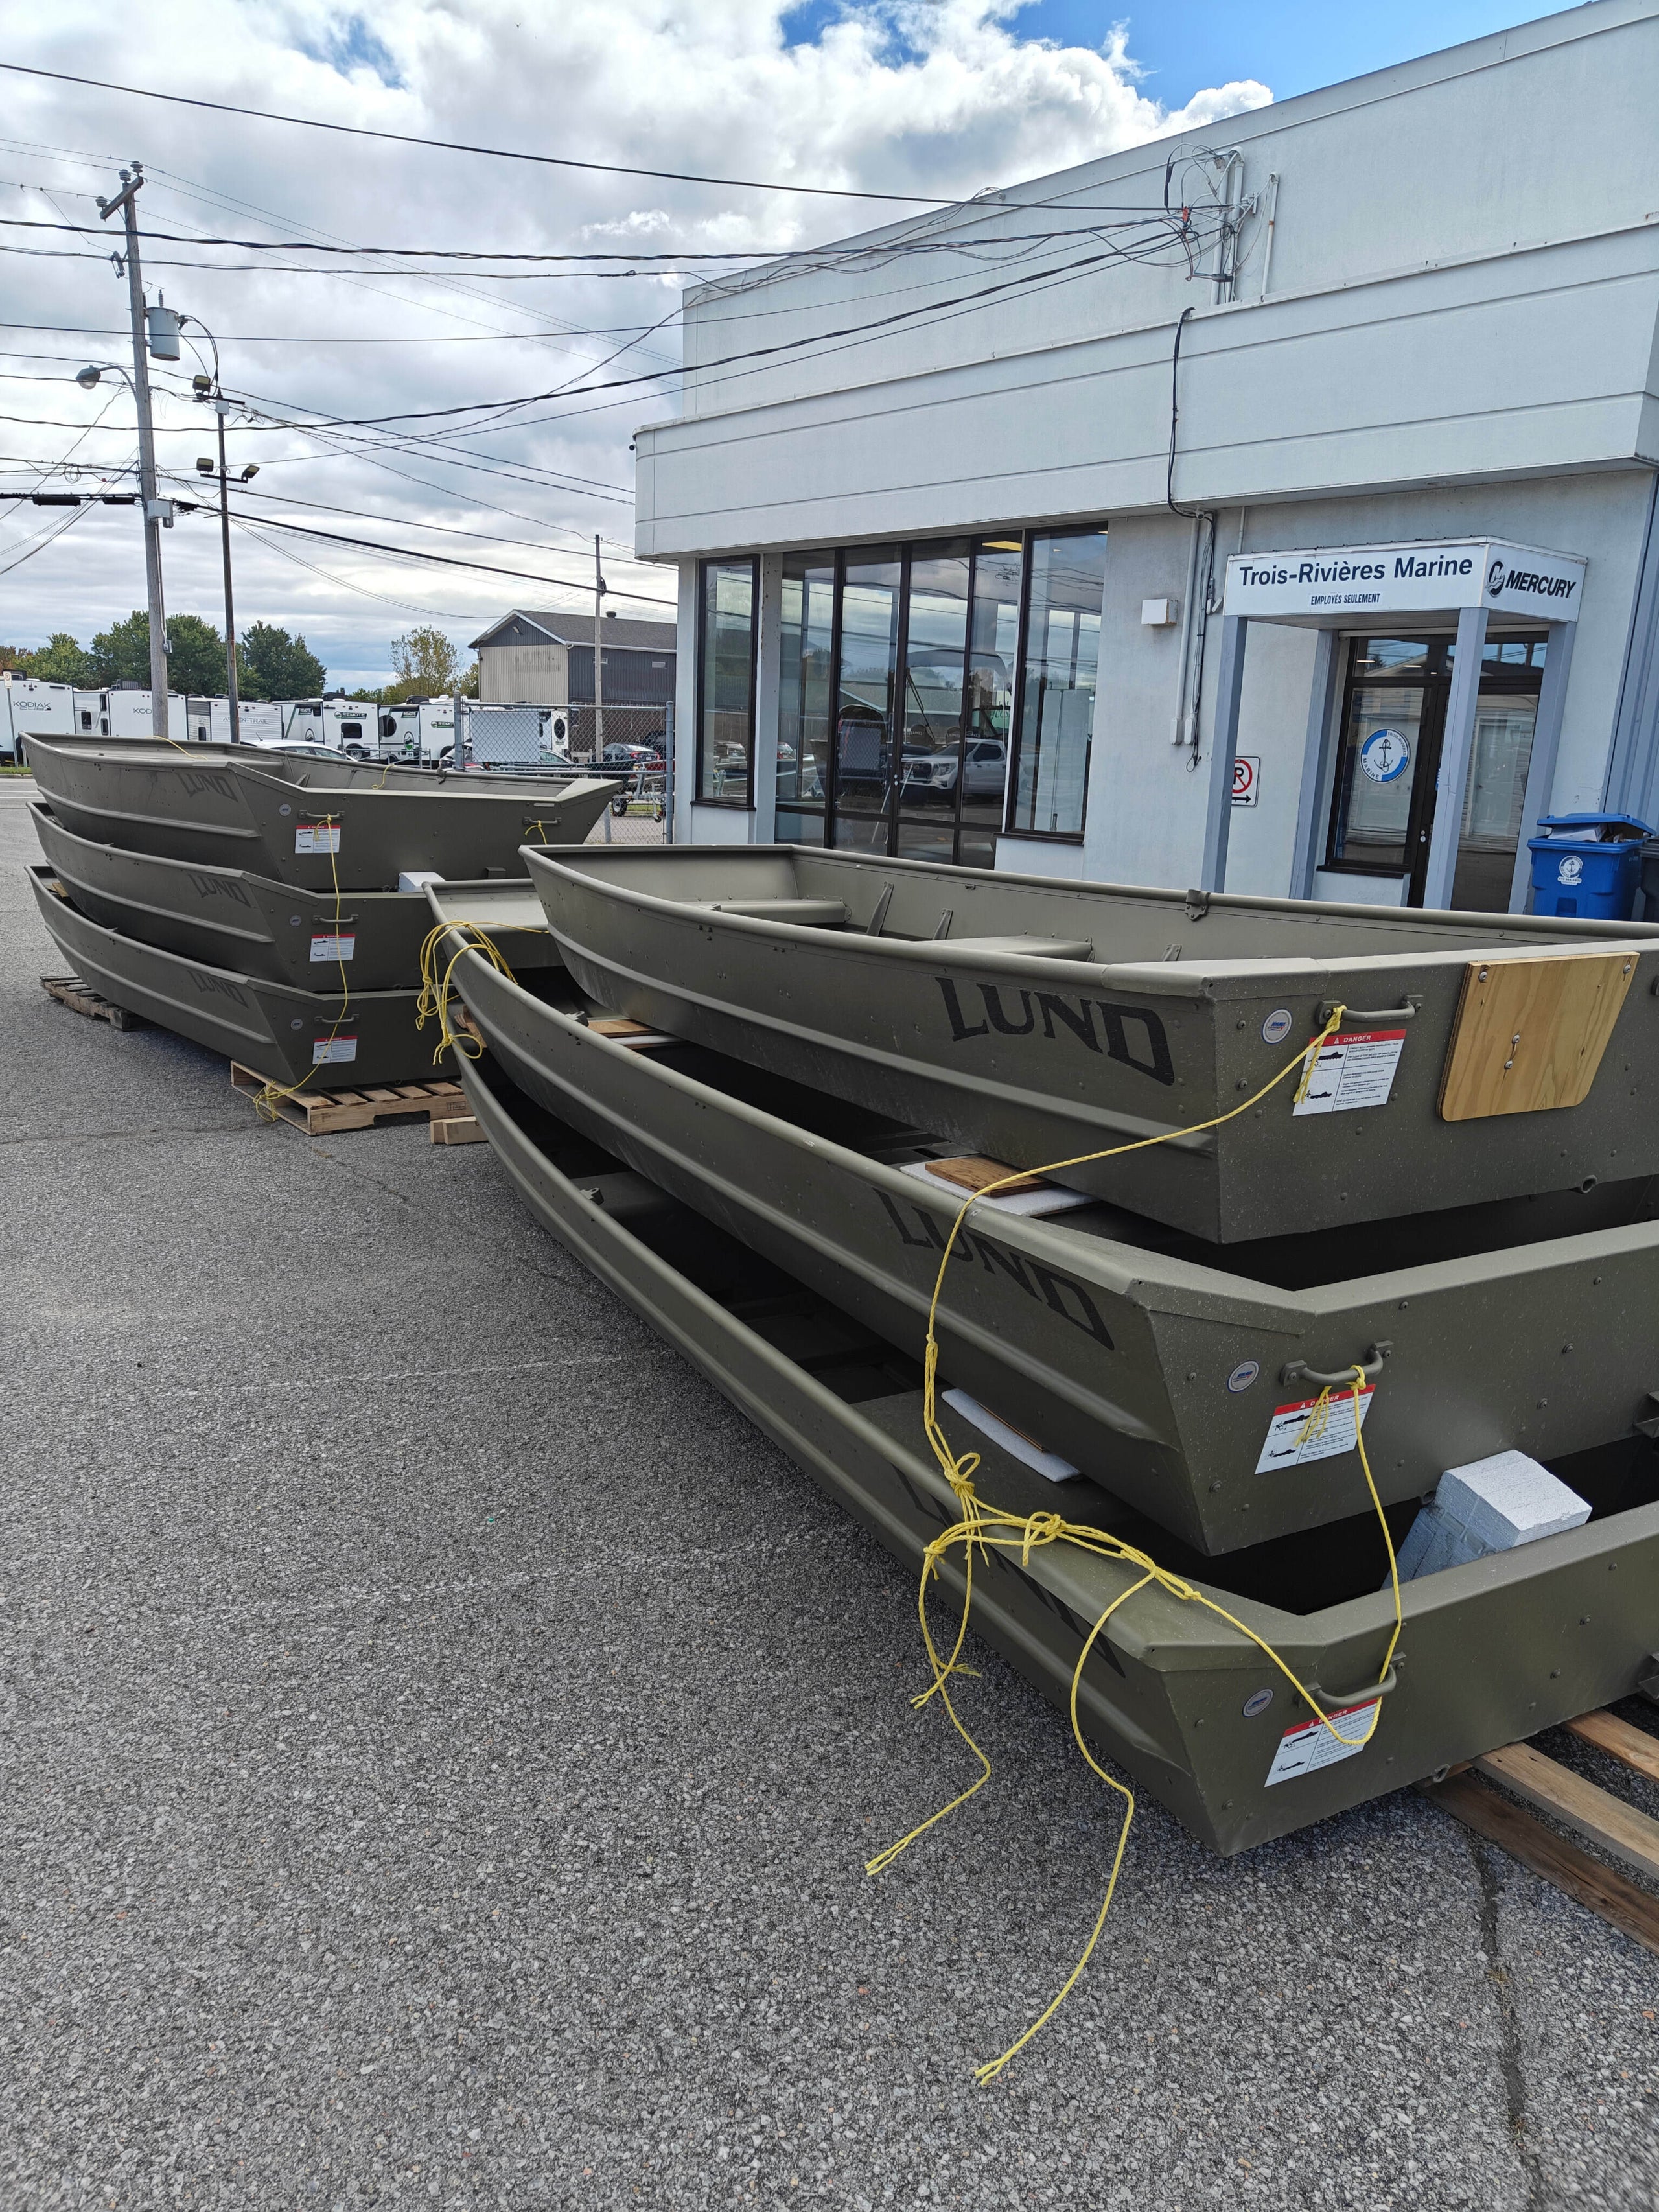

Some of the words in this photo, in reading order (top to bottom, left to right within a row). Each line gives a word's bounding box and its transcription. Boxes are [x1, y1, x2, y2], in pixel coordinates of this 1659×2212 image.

[1239, 561, 1386, 586] Trois-Rivières
[1393, 555, 1473, 579] Marine
[1505, 570, 1577, 599] MERCURY
[1310, 594, 1343, 605] EMPLOYÉS
[1343, 593, 1381, 603] SEULEMENT
[1362, 758, 1380, 780] MARINE
[935, 977, 1175, 1086] LUND
[1343, 1034, 1372, 1043] DANGER
[872, 1187, 1115, 1351] LUND
[1318, 1710, 1348, 1724] DNGER
